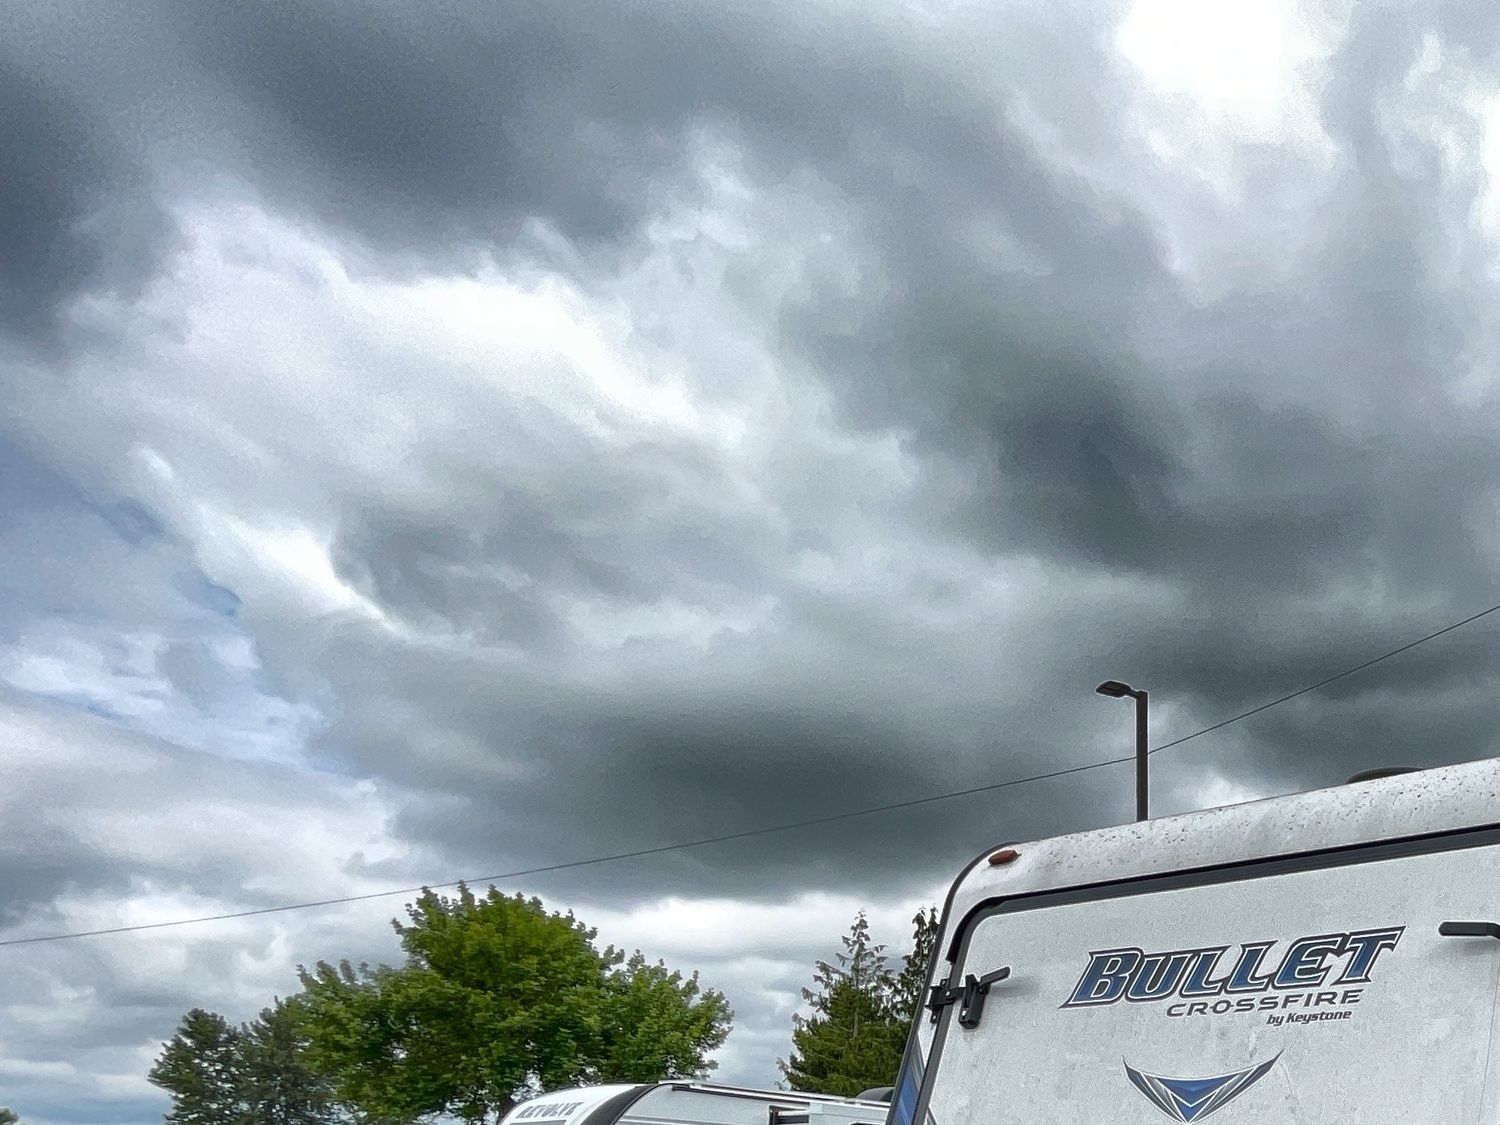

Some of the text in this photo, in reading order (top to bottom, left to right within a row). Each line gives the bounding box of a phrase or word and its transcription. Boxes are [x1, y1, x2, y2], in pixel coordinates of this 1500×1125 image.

[1058, 926, 1406, 1009] BULLET
[1166, 988, 1365, 1018] CROSSFIRE
[1266, 1010, 1352, 1027] by Keystone
